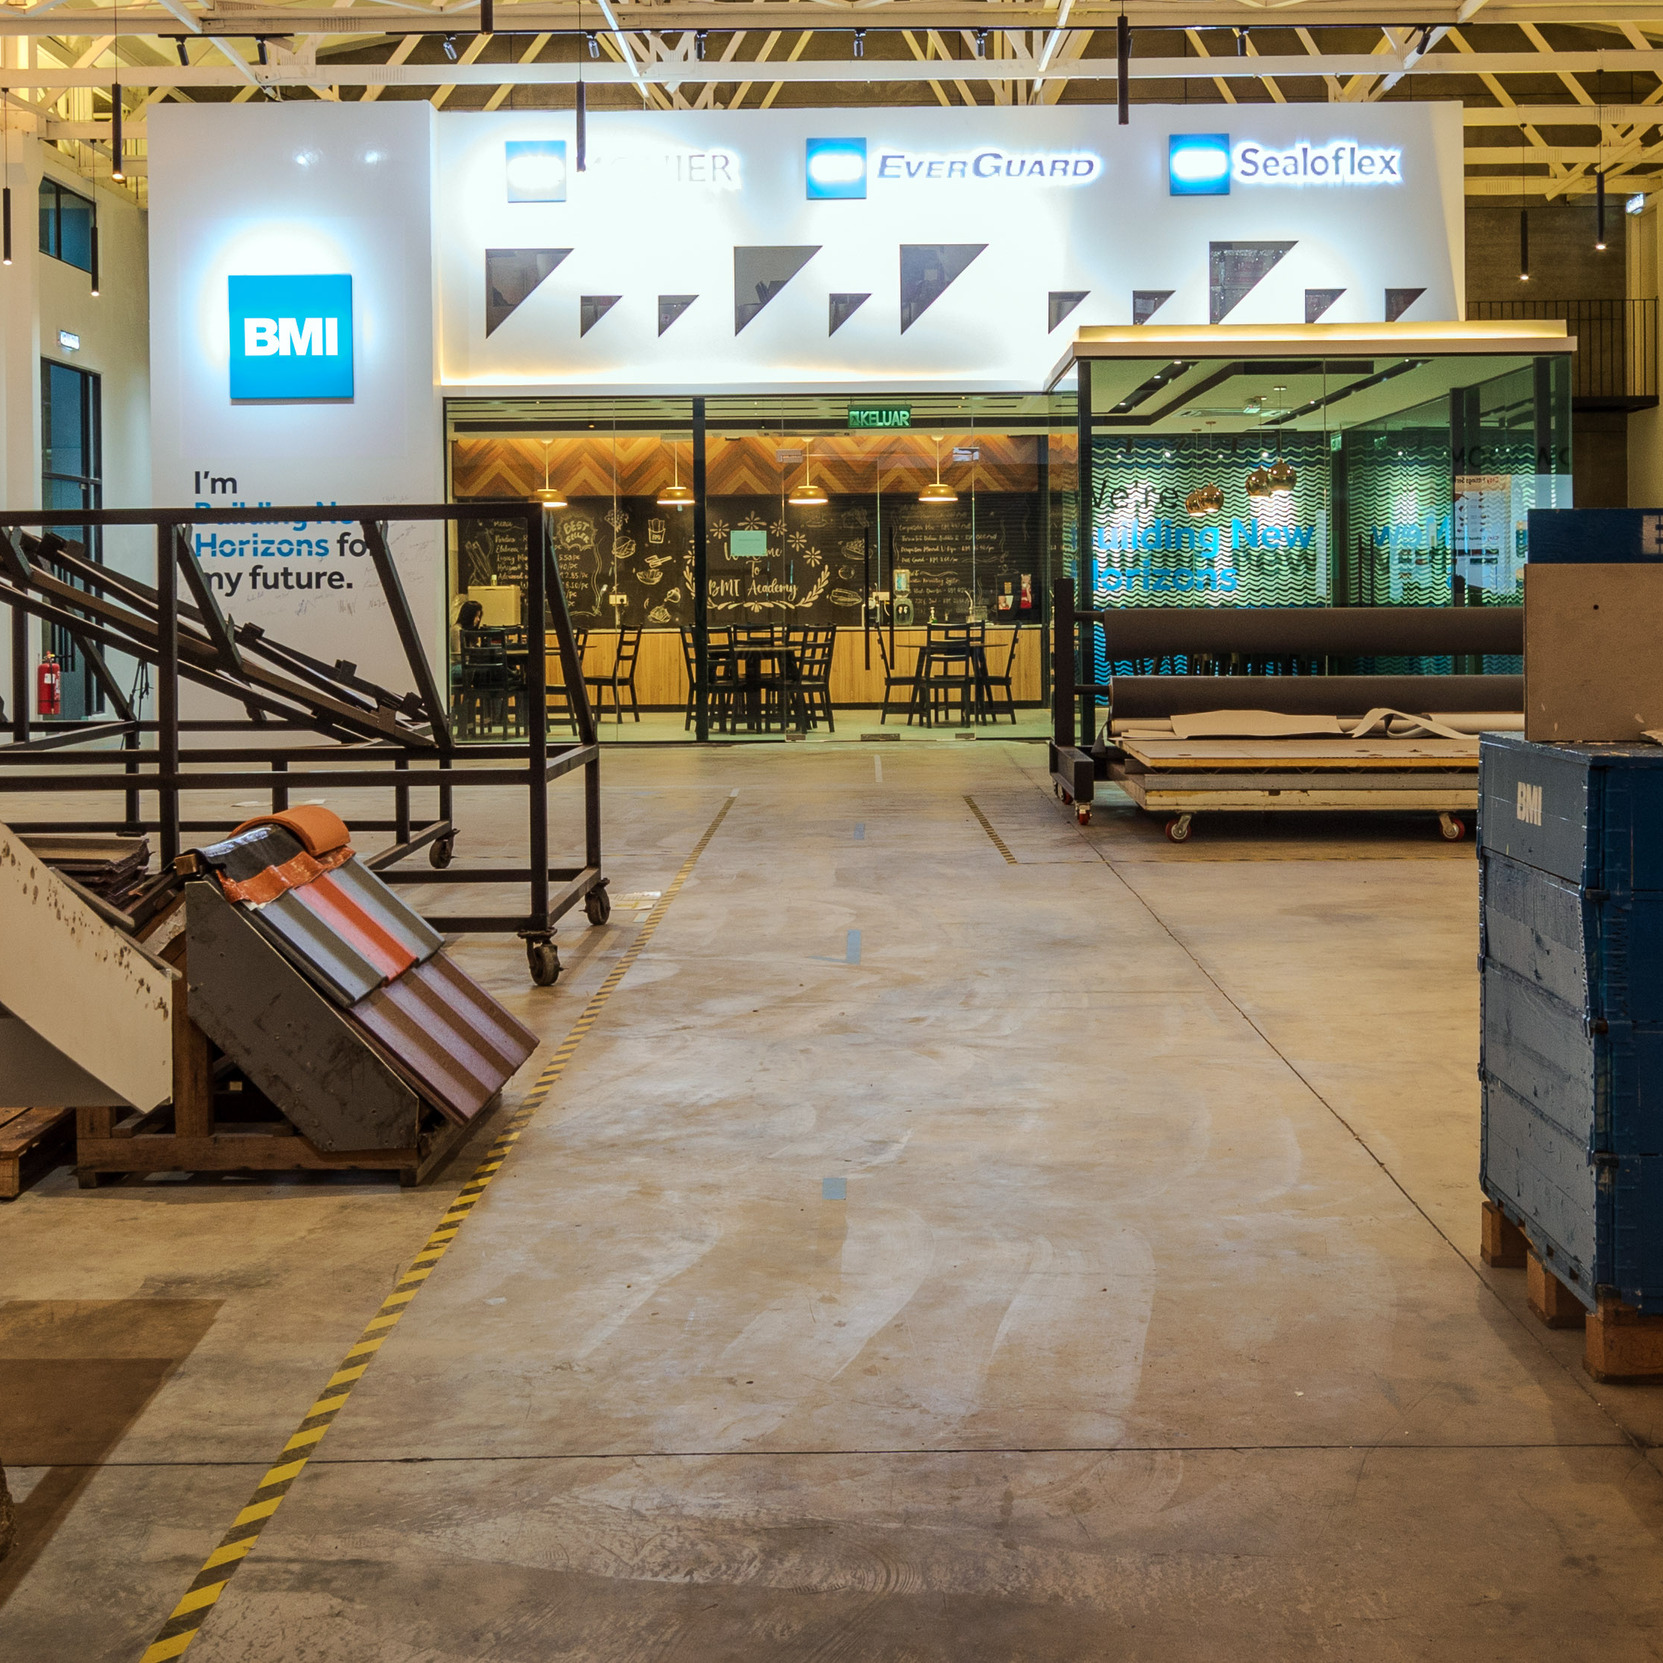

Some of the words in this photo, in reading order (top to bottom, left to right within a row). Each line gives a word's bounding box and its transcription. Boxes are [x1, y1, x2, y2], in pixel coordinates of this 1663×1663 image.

[1240, 146, 1398, 177] Sealoflex
[244, 317, 339, 357] BMI
[860, 410, 910, 426] KELUAR
[195, 470, 238, 495] I'm
[563, 520, 590, 534] BEST
[1230, 517, 1314, 550] New
[195, 532, 329, 558] Horizons
[337, 531, 373, 558] fo
[249, 564, 353, 590] future.
[745, 560, 761, 578] To
[747, 577, 799, 602] Academy
[1516, 781, 1543, 826] BMI
